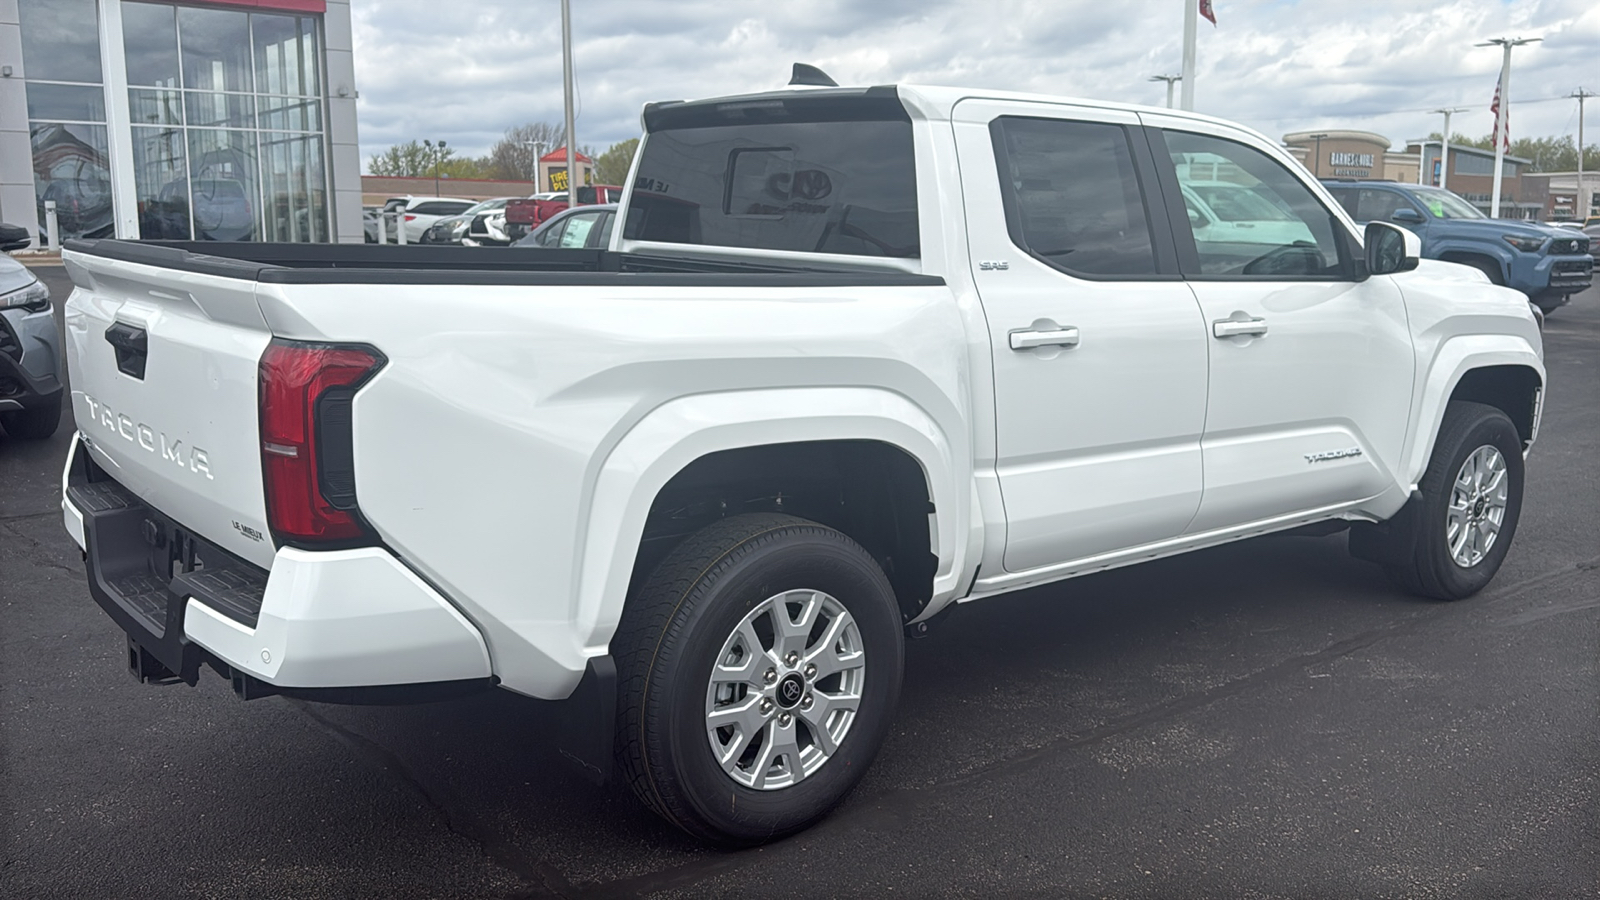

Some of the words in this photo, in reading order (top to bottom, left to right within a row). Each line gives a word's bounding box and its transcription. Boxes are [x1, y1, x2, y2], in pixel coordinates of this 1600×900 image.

[550, 170, 568, 183] TIRE
[553, 179, 568, 191] PLU
[84, 394, 214, 480] TACOMA
[1304, 447, 1362, 464] TACOMA
[231, 519, 241, 531] LE
